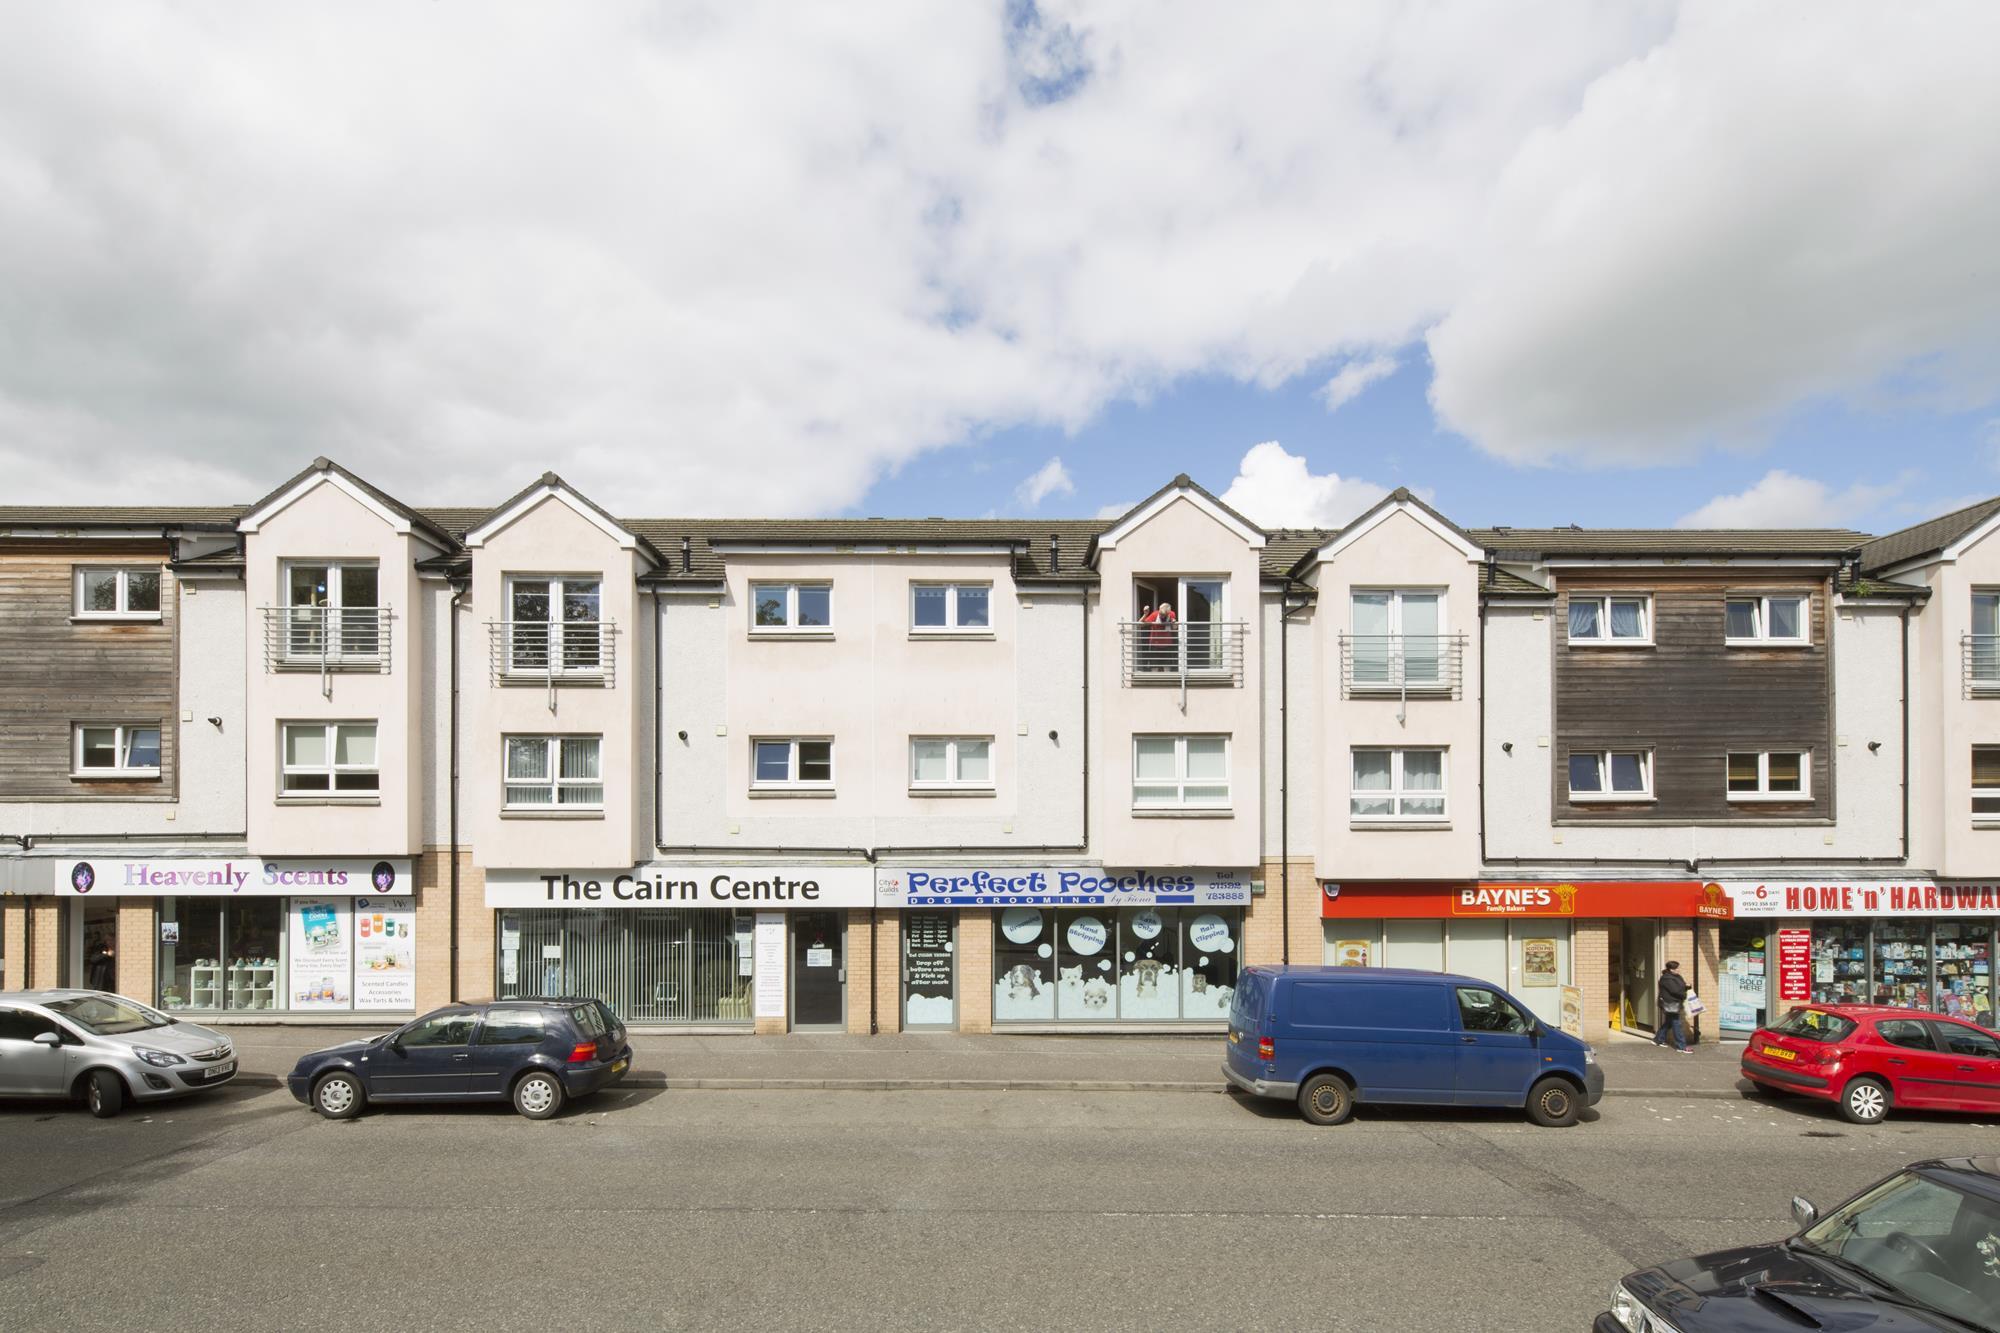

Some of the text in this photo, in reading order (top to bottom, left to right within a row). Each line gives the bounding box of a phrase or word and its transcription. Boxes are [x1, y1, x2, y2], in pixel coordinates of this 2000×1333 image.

[124, 863, 348, 892] Heavenly Scents
[540, 874, 820, 900] The Cairn Centre
[907, 869, 1195, 894] Perfect Pooches
[976, 896, 1097, 904] GROOMING
[1461, 887, 1551, 905] BAYNE'S
[1756, 885, 1767, 899] 6
[1785, 886, 1853, 911] HOME
[1890, 886, 2000, 911] HARDWA
[1195, 930, 1225, 943] Clipping
